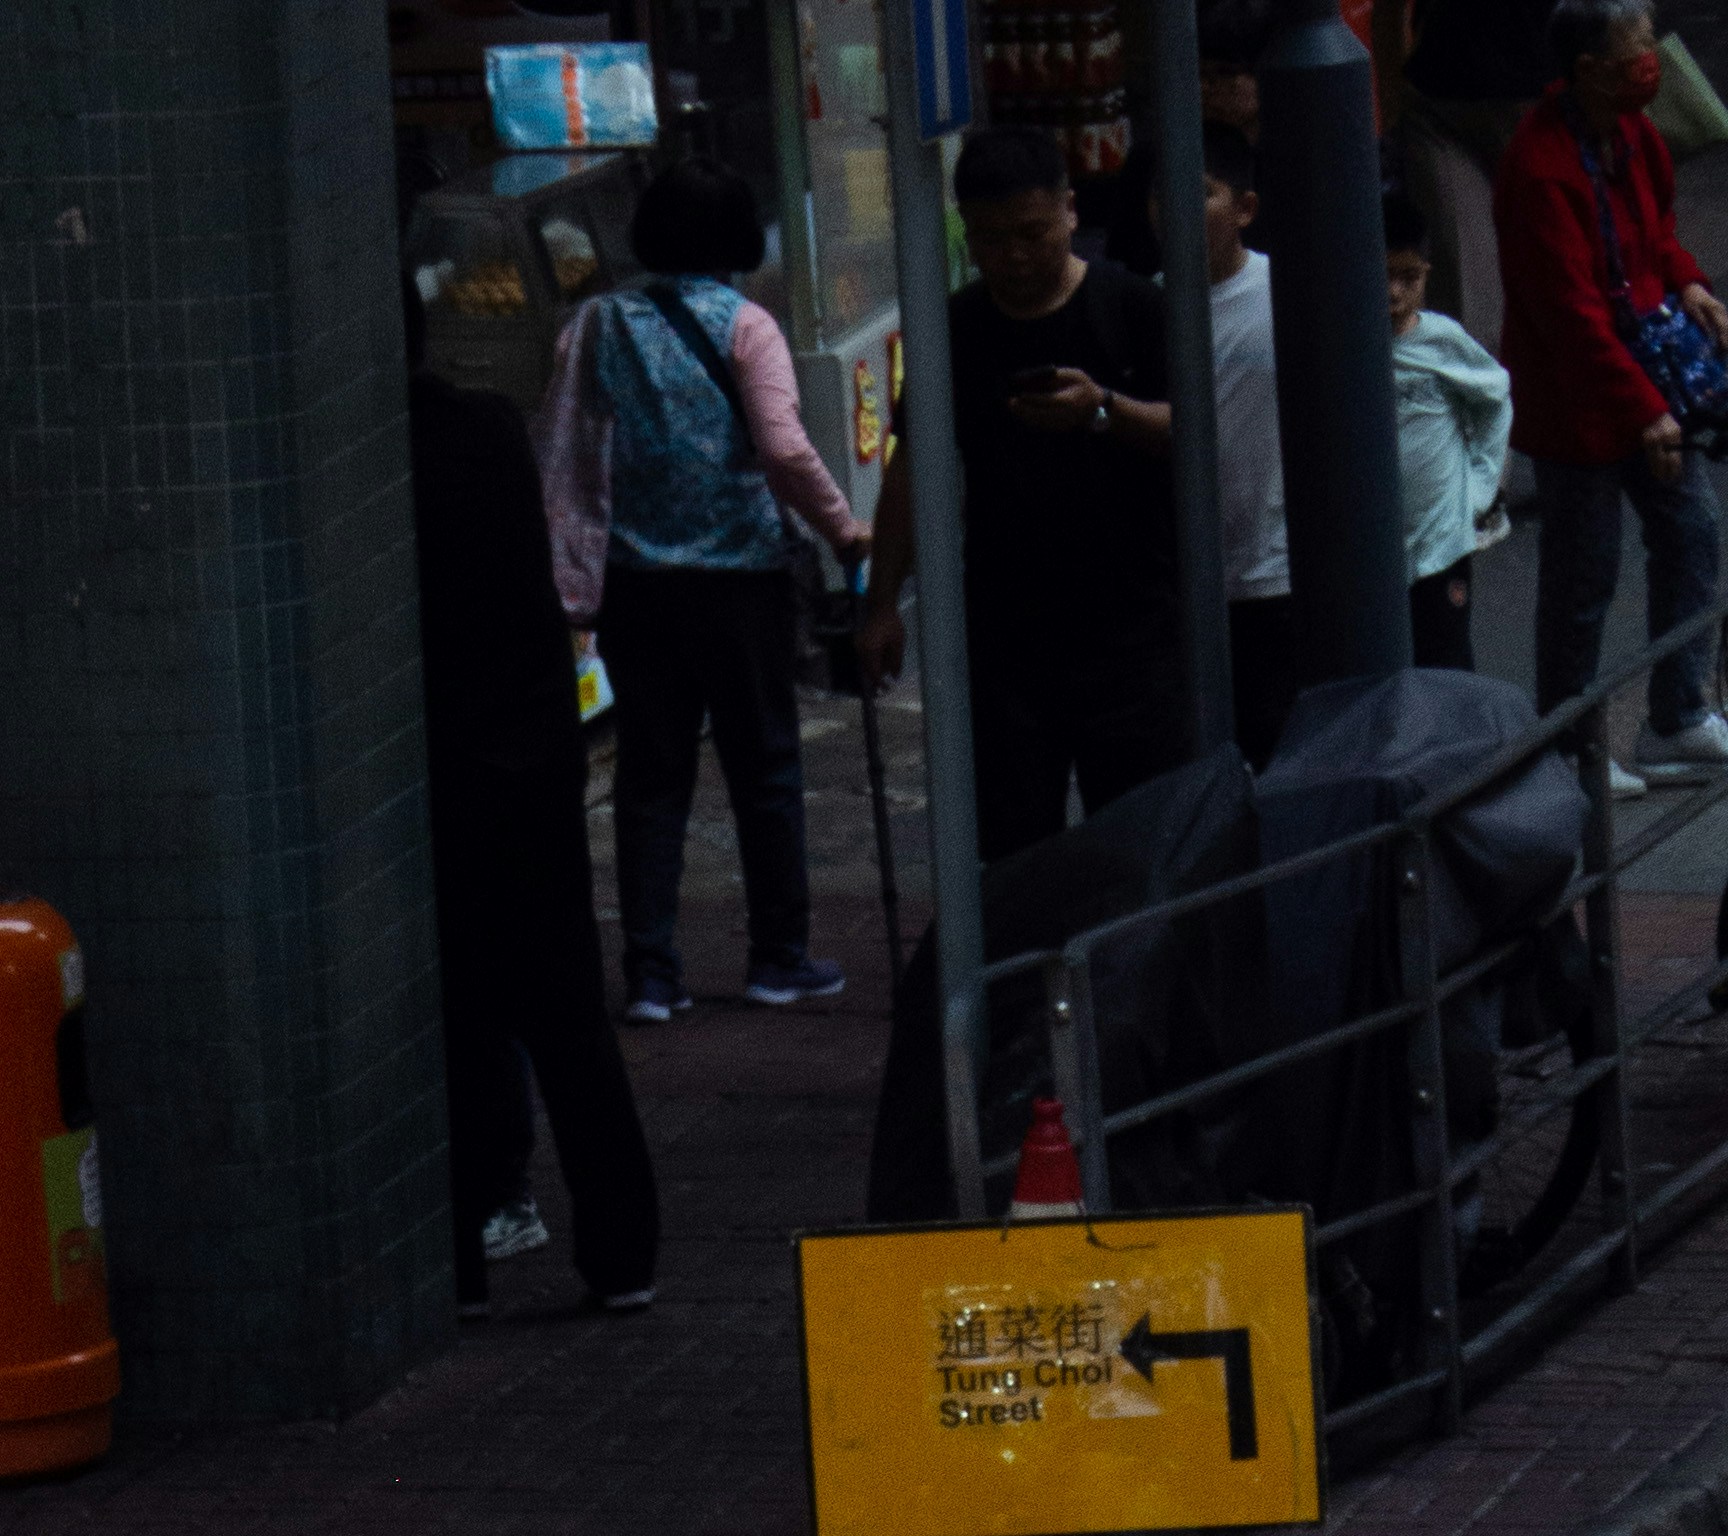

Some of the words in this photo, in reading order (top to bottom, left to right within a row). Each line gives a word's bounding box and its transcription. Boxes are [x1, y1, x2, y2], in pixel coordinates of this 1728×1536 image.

[936, 1302, 1105, 1361] 通菜街
[936, 1364, 1023, 1396] Tung
[1034, 1355, 1114, 1388] Choi
[939, 1396, 1044, 1429] Street
